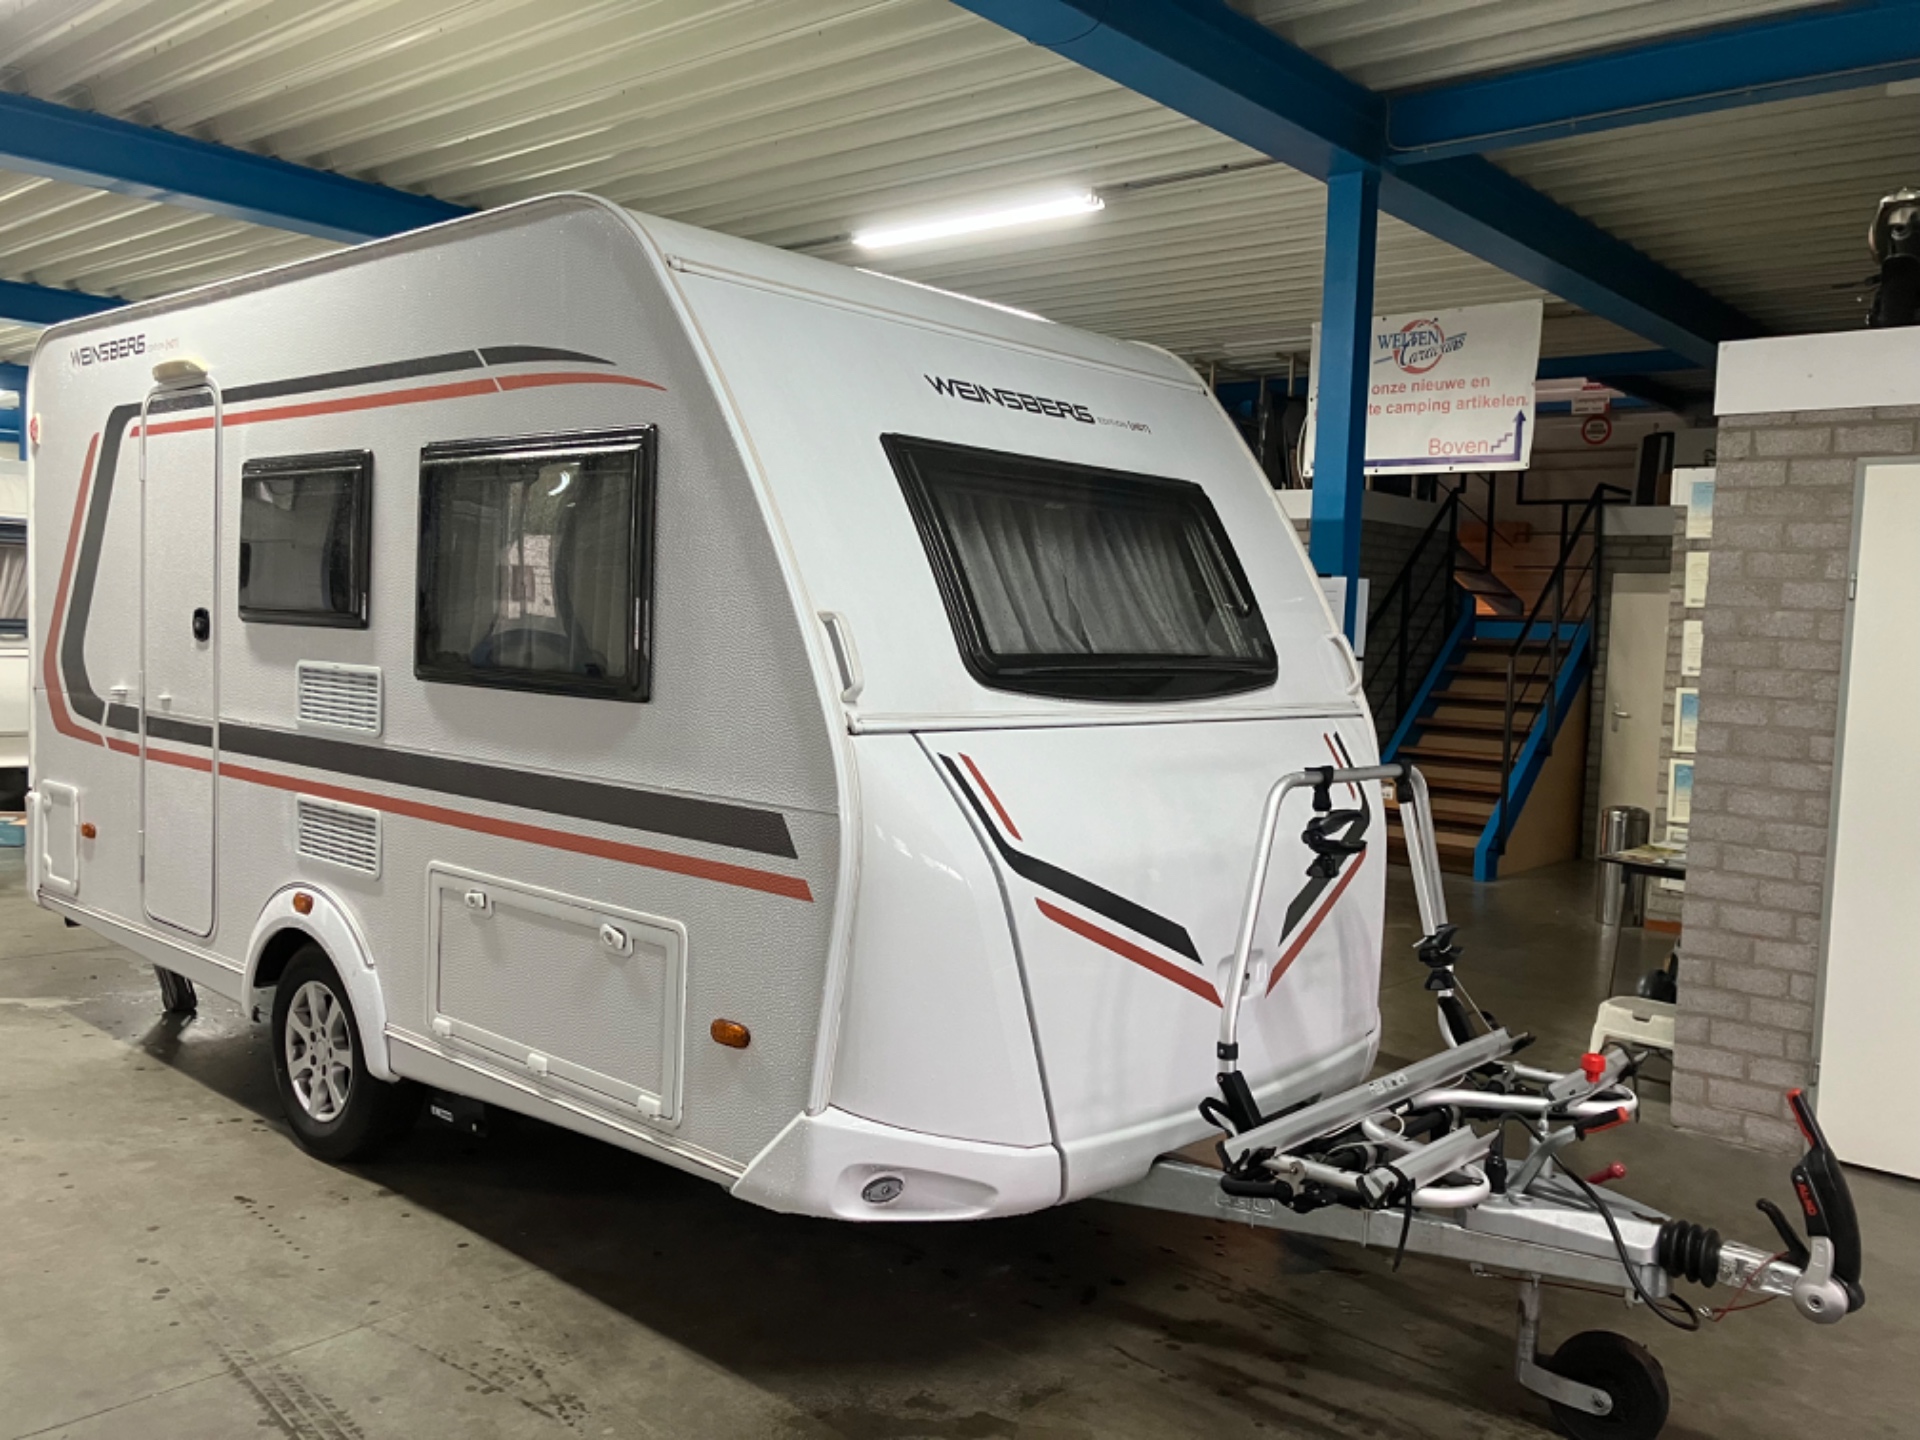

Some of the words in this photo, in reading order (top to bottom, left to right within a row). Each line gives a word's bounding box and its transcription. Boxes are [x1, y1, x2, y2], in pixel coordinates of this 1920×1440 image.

[1377, 329, 1440, 350] WELTEN
[70, 334, 146, 367] WEINSBERG
[1371, 381, 1407, 395] onze
[1411, 378, 1465, 392] nieuwe
[1471, 377, 1490, 388] en
[924, 374, 1096, 424] WEINSBERG
[1386, 400, 1450, 415] camping
[1428, 438, 1489, 455] Boven
